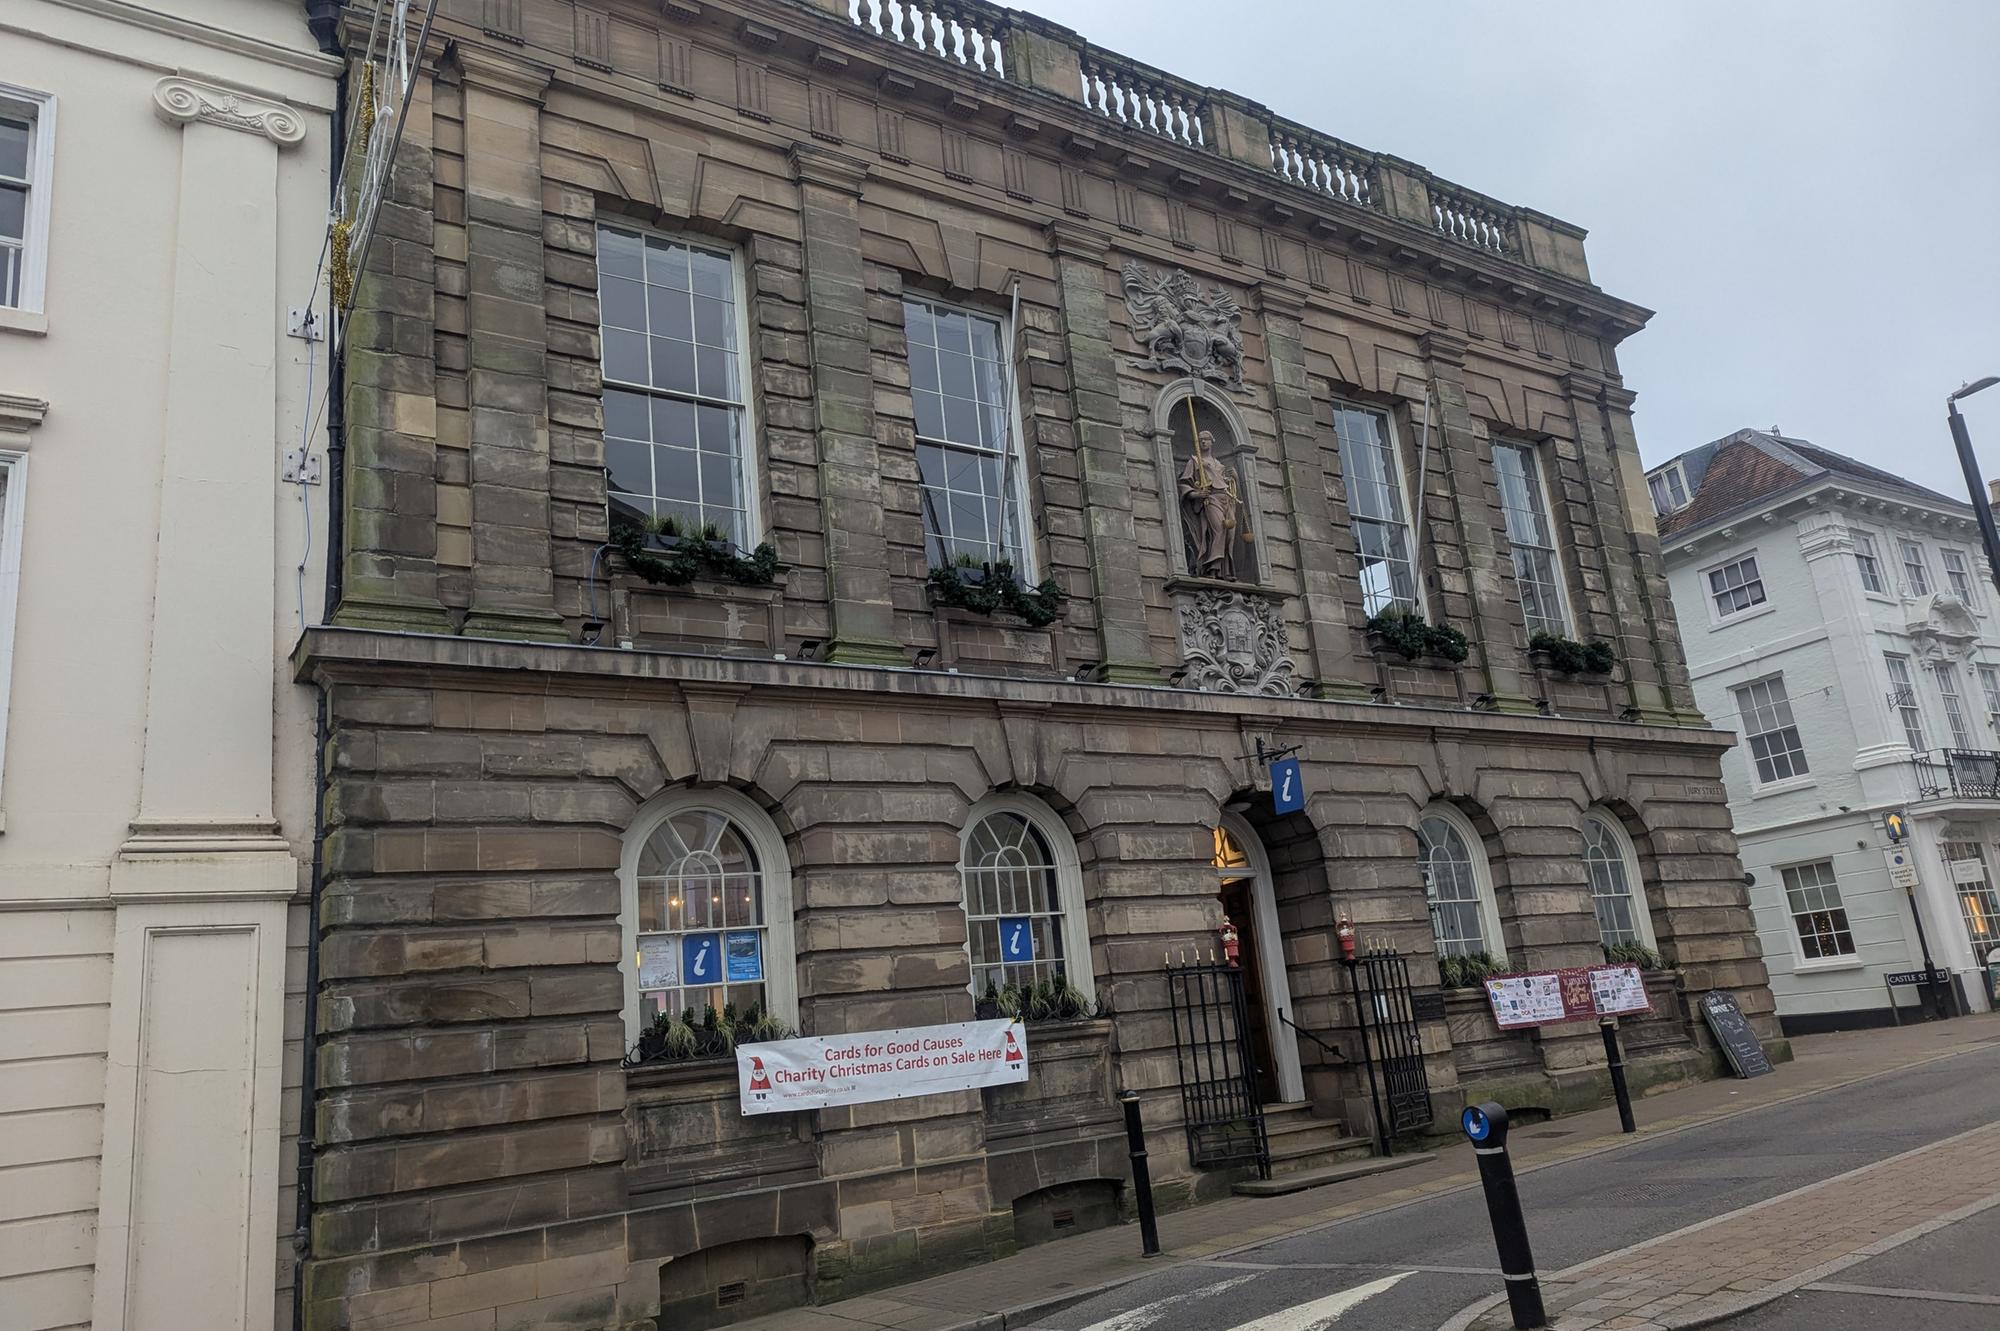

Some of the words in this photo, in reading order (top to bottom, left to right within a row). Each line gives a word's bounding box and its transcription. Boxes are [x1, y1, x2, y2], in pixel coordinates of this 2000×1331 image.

[1702, 786, 1723, 795] STREET
[1889, 974, 1916, 983] CASTLE
[1918, 971, 1945, 981] STET
[825, 1046, 861, 1061] Cards
[864, 1044, 884, 1057] for
[887, 1040, 920, 1055] Good
[923, 1038, 963, 1051] Causes
[775, 1067, 826, 1083] Charity
[829, 1061, 893, 1078] Christmas
[896, 1055, 930, 1070] Cards
[933, 1057, 948, 1067] on
[951, 1050, 976, 1064] Sale
[978, 1048, 1002, 1060] Here
